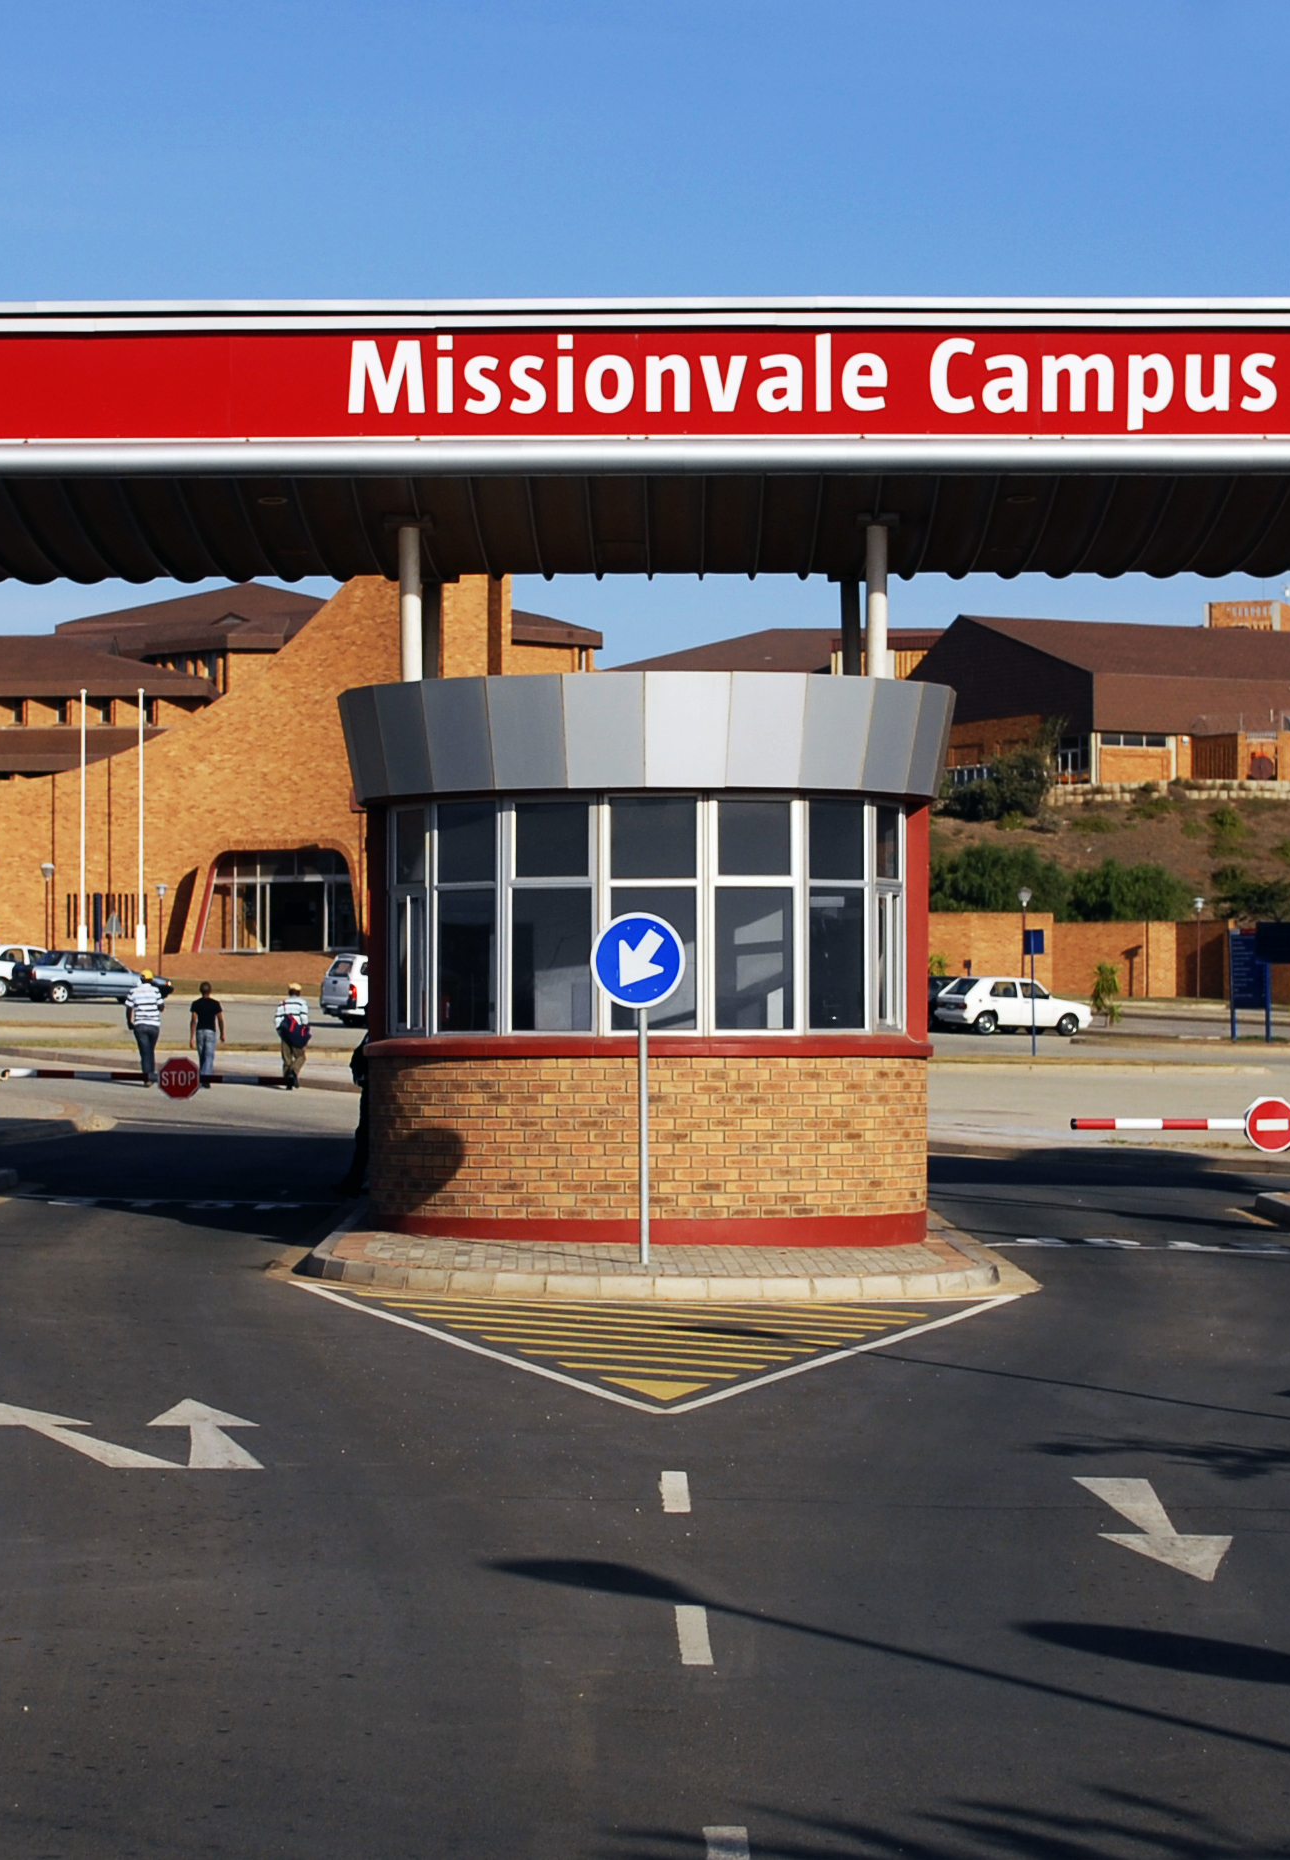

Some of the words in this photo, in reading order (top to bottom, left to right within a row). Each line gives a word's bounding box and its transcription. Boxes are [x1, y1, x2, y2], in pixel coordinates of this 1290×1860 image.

[348, 333, 888, 416] Missionvale
[928, 337, 1278, 431] Campus
[161, 1070, 196, 1087] STOP
